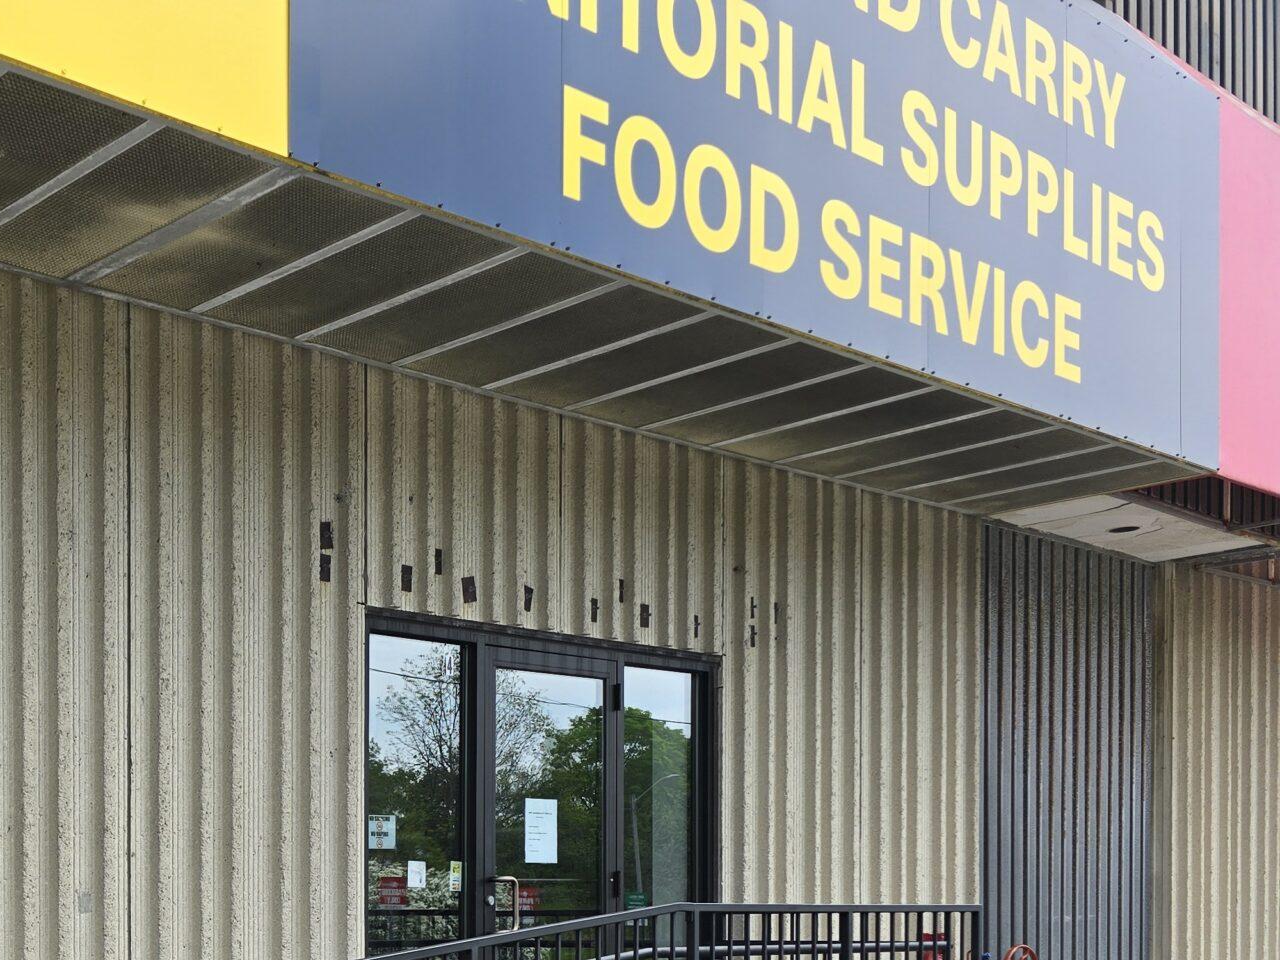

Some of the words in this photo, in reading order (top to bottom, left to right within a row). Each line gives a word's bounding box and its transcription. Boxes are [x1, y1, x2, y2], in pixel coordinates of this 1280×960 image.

[547, 0, 884, 165] ORIAL
[901, 90, 1165, 292] SUPPLIES
[939, 0, 1126, 148] CARRY
[562, 85, 800, 274] FOOD
[820, 199, 1082, 384] SERVICE
